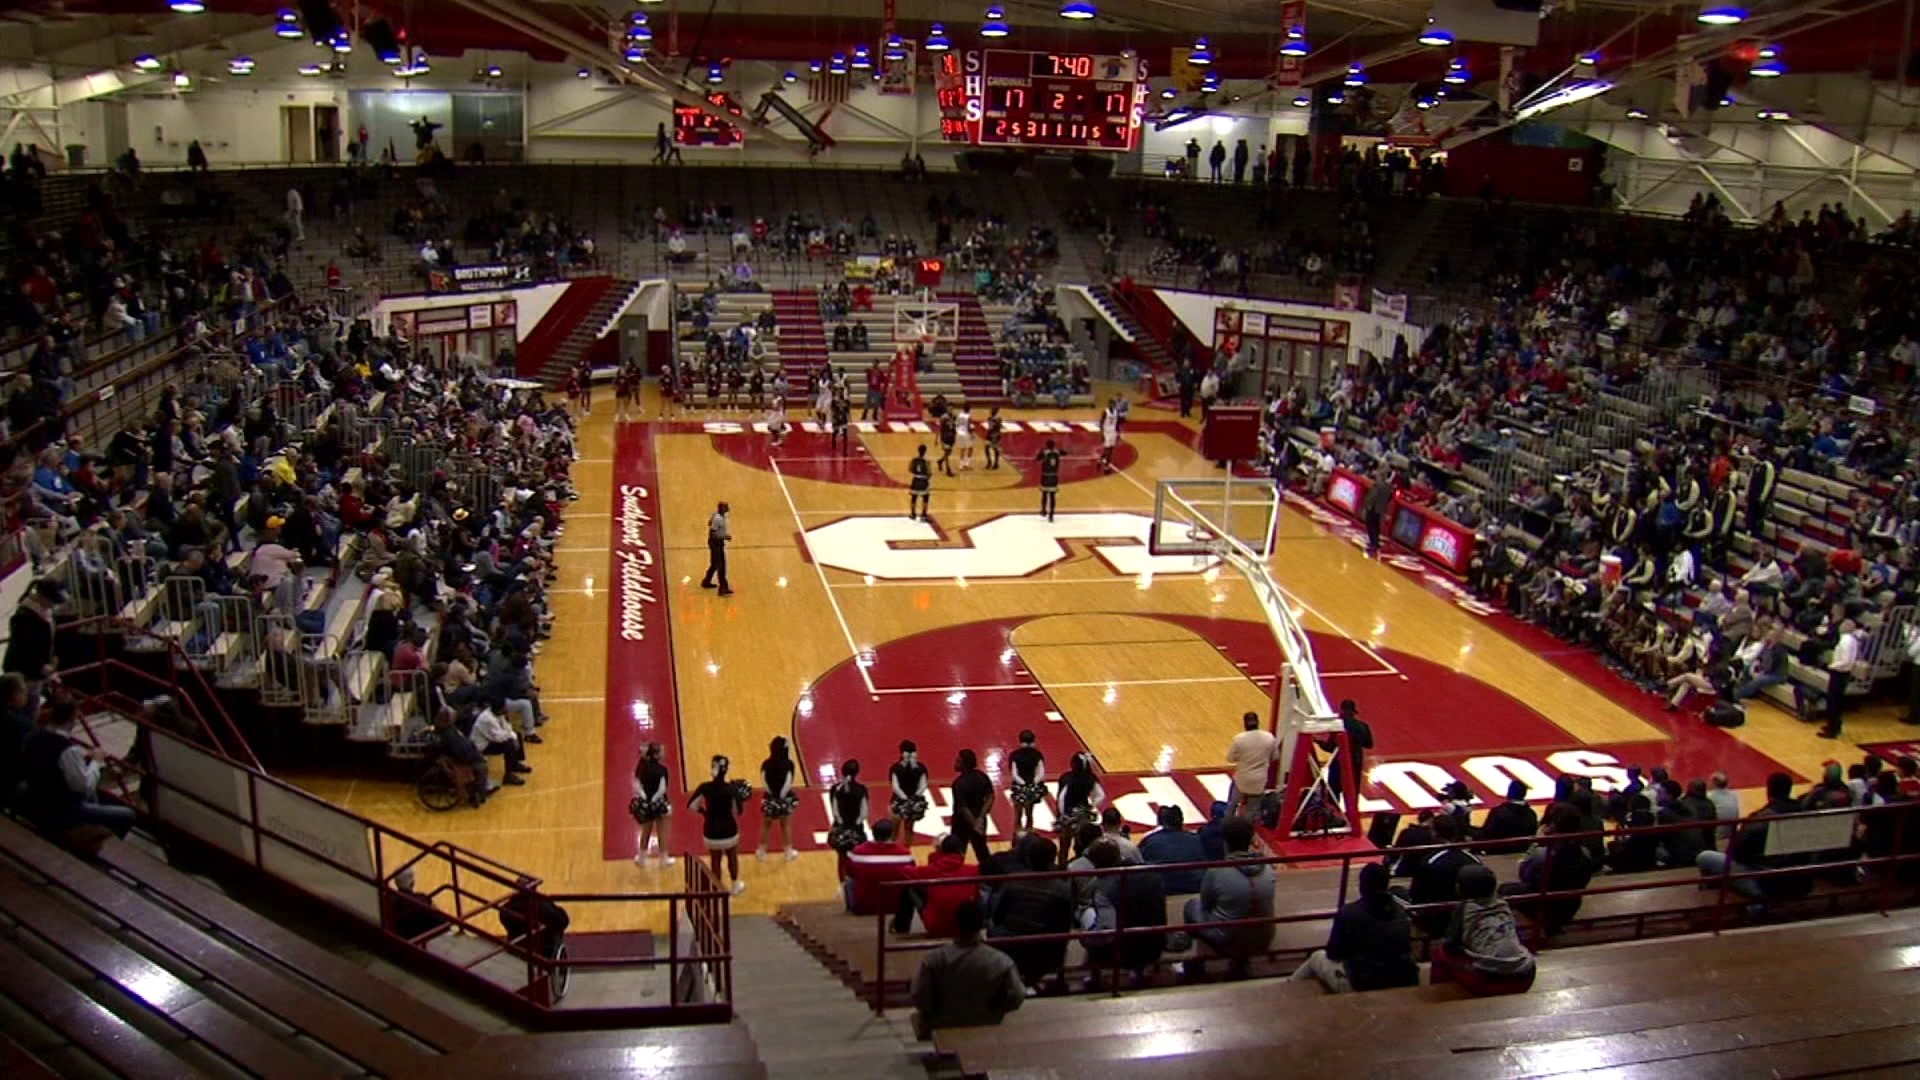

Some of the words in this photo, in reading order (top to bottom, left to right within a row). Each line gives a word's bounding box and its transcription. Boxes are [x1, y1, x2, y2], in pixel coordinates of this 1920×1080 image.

[1048, 55, 1090, 77] 7:40
[965, 50, 981, 122] SHS
[1131, 59, 1148, 128] SHS
[1006, 89, 1024, 108] 17
[1053, 93, 1065, 110] 2
[1106, 93, 1125, 113] 17
[995, 119, 1006, 136] 2
[615, 486, 652, 547] Southport
[615, 549, 657, 641] Fieldhouse
